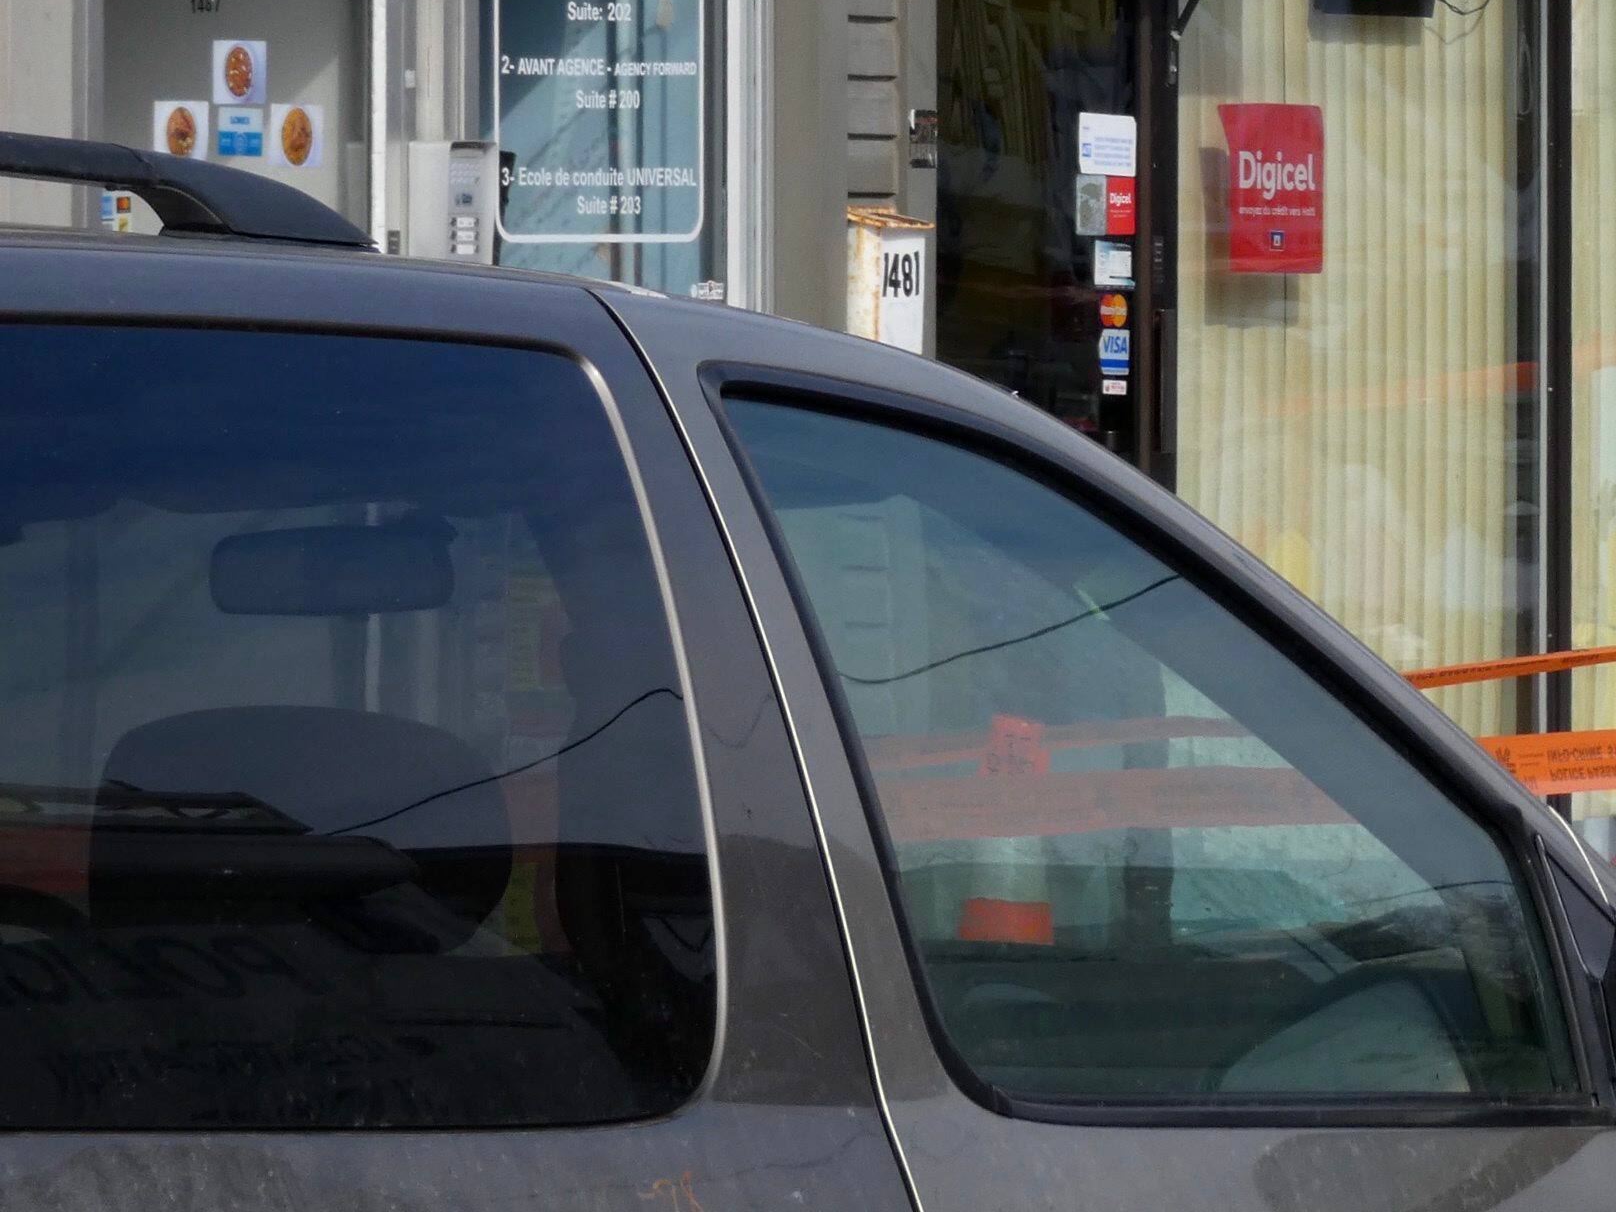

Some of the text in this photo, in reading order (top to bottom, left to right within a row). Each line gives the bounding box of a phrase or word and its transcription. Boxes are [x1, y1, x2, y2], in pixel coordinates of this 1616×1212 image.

[568, 1, 632, 22] Suite: 202
[517, 58, 555, 75] AVANT
[556, 58, 605, 76] AGENCE
[613, 62, 650, 76] AGENCY
[652, 61, 697, 76] FORWARD
[575, 90, 607, 109] Suite
[619, 90, 640, 109] 200
[518, 167, 552, 186] Ecole
[555, 167, 570, 186] de
[573, 167, 624, 186] conduite
[626, 167, 697, 186] UNIVERSAL
[1239, 149, 1316, 201] Digicel
[577, 195, 607, 214] Suite
[620, 196, 641, 214] 203
[1109, 192, 1132, 207] Digicel
[882, 250, 922, 299] 1481
[1103, 335, 1128, 354] VISA
